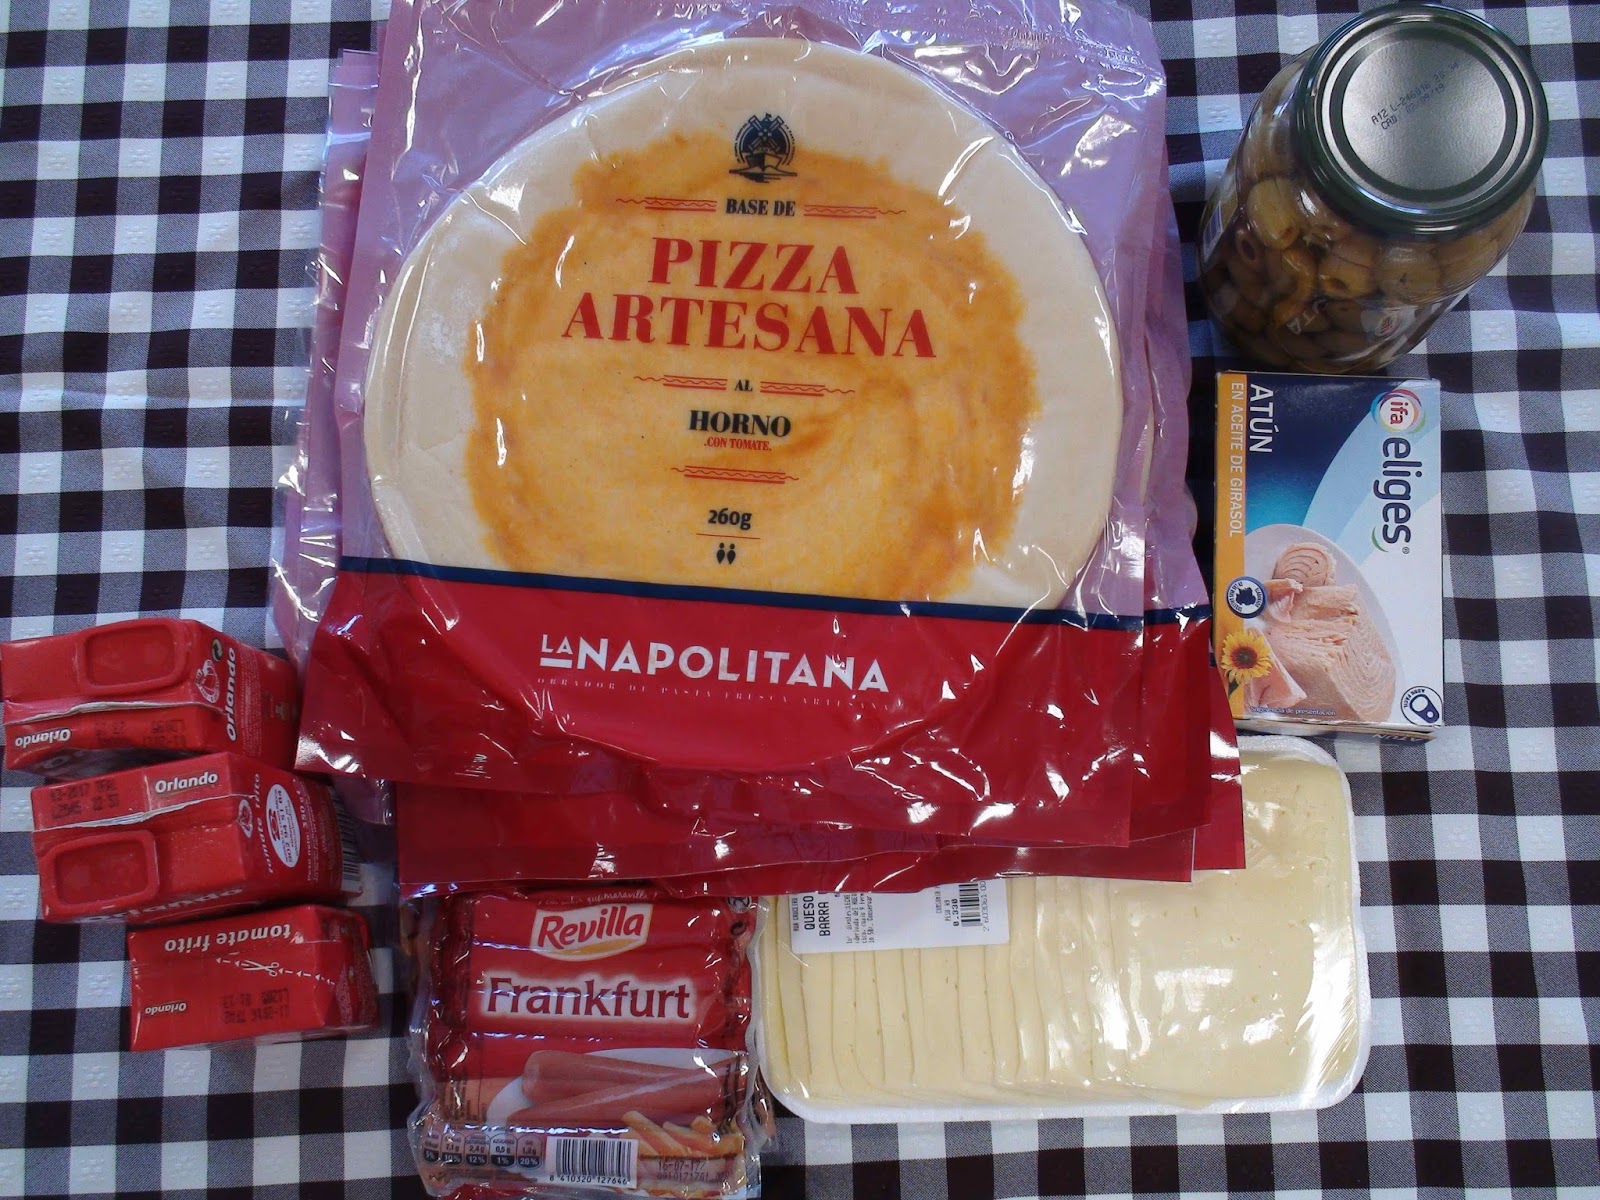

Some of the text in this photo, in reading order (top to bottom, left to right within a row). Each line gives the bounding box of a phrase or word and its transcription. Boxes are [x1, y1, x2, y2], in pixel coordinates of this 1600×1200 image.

[1371, 109, 1388, 125] A12
[725, 198, 796, 217] BASE DE
[647, 236, 859, 295] PIZZA
[560, 291, 936, 358] ARTESANA
[734, 379, 753, 392] AL
[688, 409, 792, 438] HORNO
[1249, 383, 1280, 453] ATÚN
[1390, 401, 1409, 425] ifa
[1229, 382, 1244, 538] EN ACEITE DE GIRASOL
[1373, 437, 1423, 544] eliges
[707, 508, 753, 531] 260g
[540, 633, 890, 693] LA NAPOLITANA
[225, 647, 237, 742] Orlando
[15, 728, 72, 748] Orlando
[155, 771, 219, 794] Orlando
[537, 904, 645, 950] Revilla
[803, 895, 815, 930] QUESO
[817, 901, 831, 937] BARRA
[164, 923, 292, 953] tomate frito
[144, 1002, 187, 1015] Orlando
[486, 977, 691, 1020] Frankfurt
